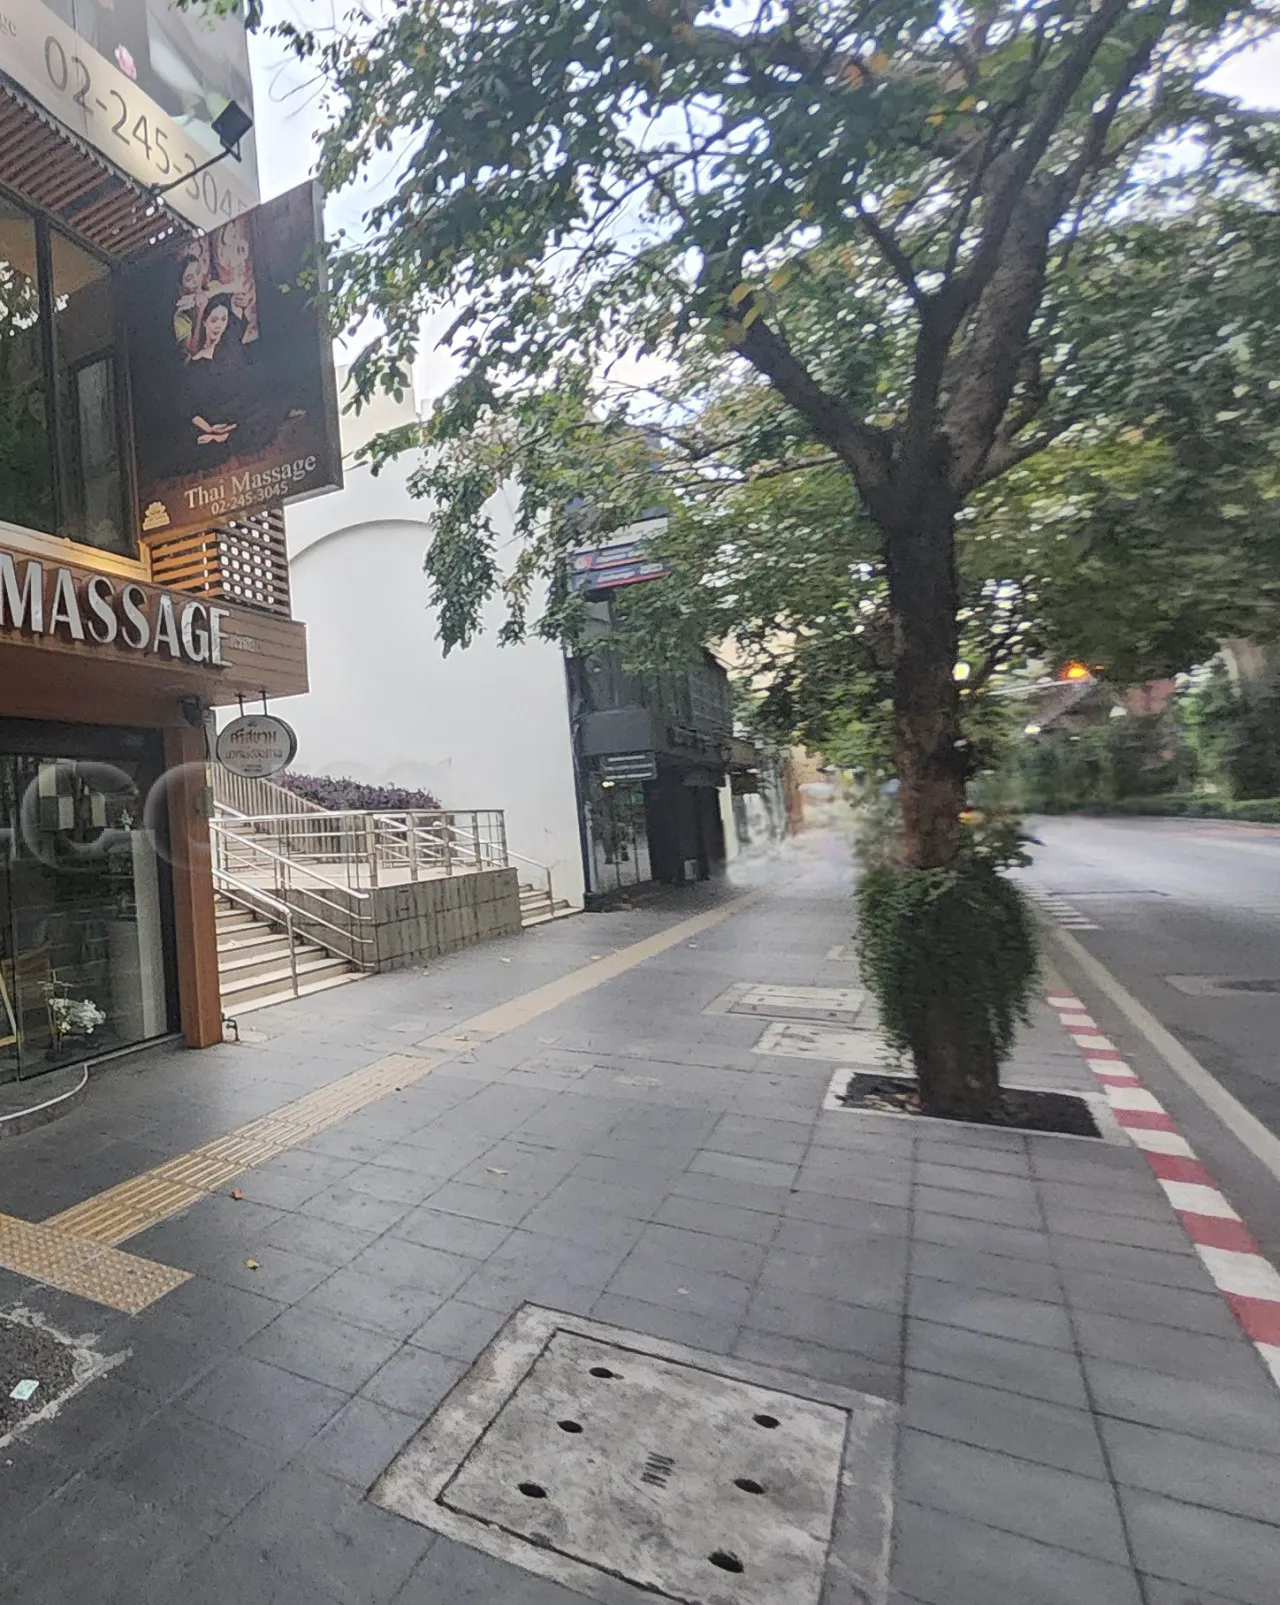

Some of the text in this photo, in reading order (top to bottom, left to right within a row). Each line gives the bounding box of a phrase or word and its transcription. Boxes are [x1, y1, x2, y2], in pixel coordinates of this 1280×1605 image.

[44, 34, 247, 218] 02-245-304
[184, 455, 316, 509] Thai Massage
[211, 481, 289, 515] 02-245-3045
